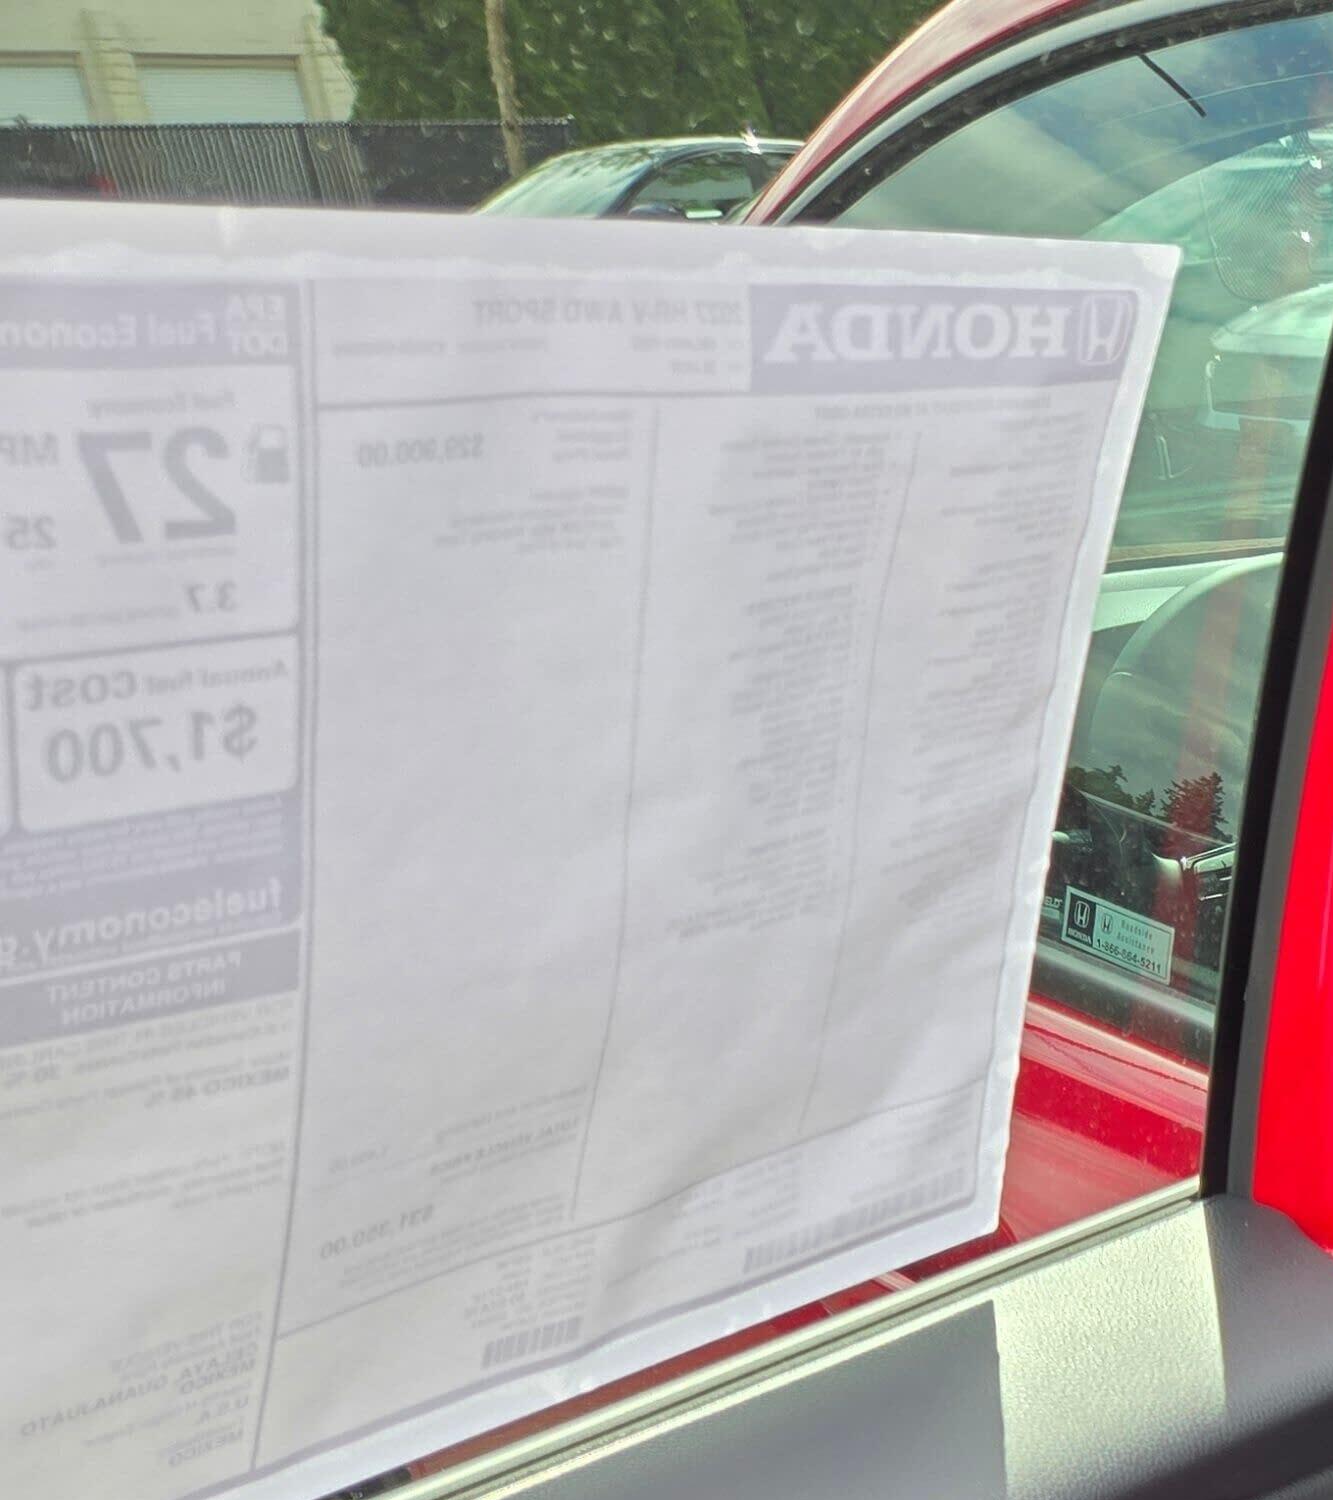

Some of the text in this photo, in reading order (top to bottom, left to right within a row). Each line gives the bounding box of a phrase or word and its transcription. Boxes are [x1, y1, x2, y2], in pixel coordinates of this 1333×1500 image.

[1068, 928, 1092, 944] HONDA
[1120, 920, 1153, 940] Roadside
[1116, 933, 1155, 955] Assistance
[1096, 939, 1161, 974] 1-866-864-5211
